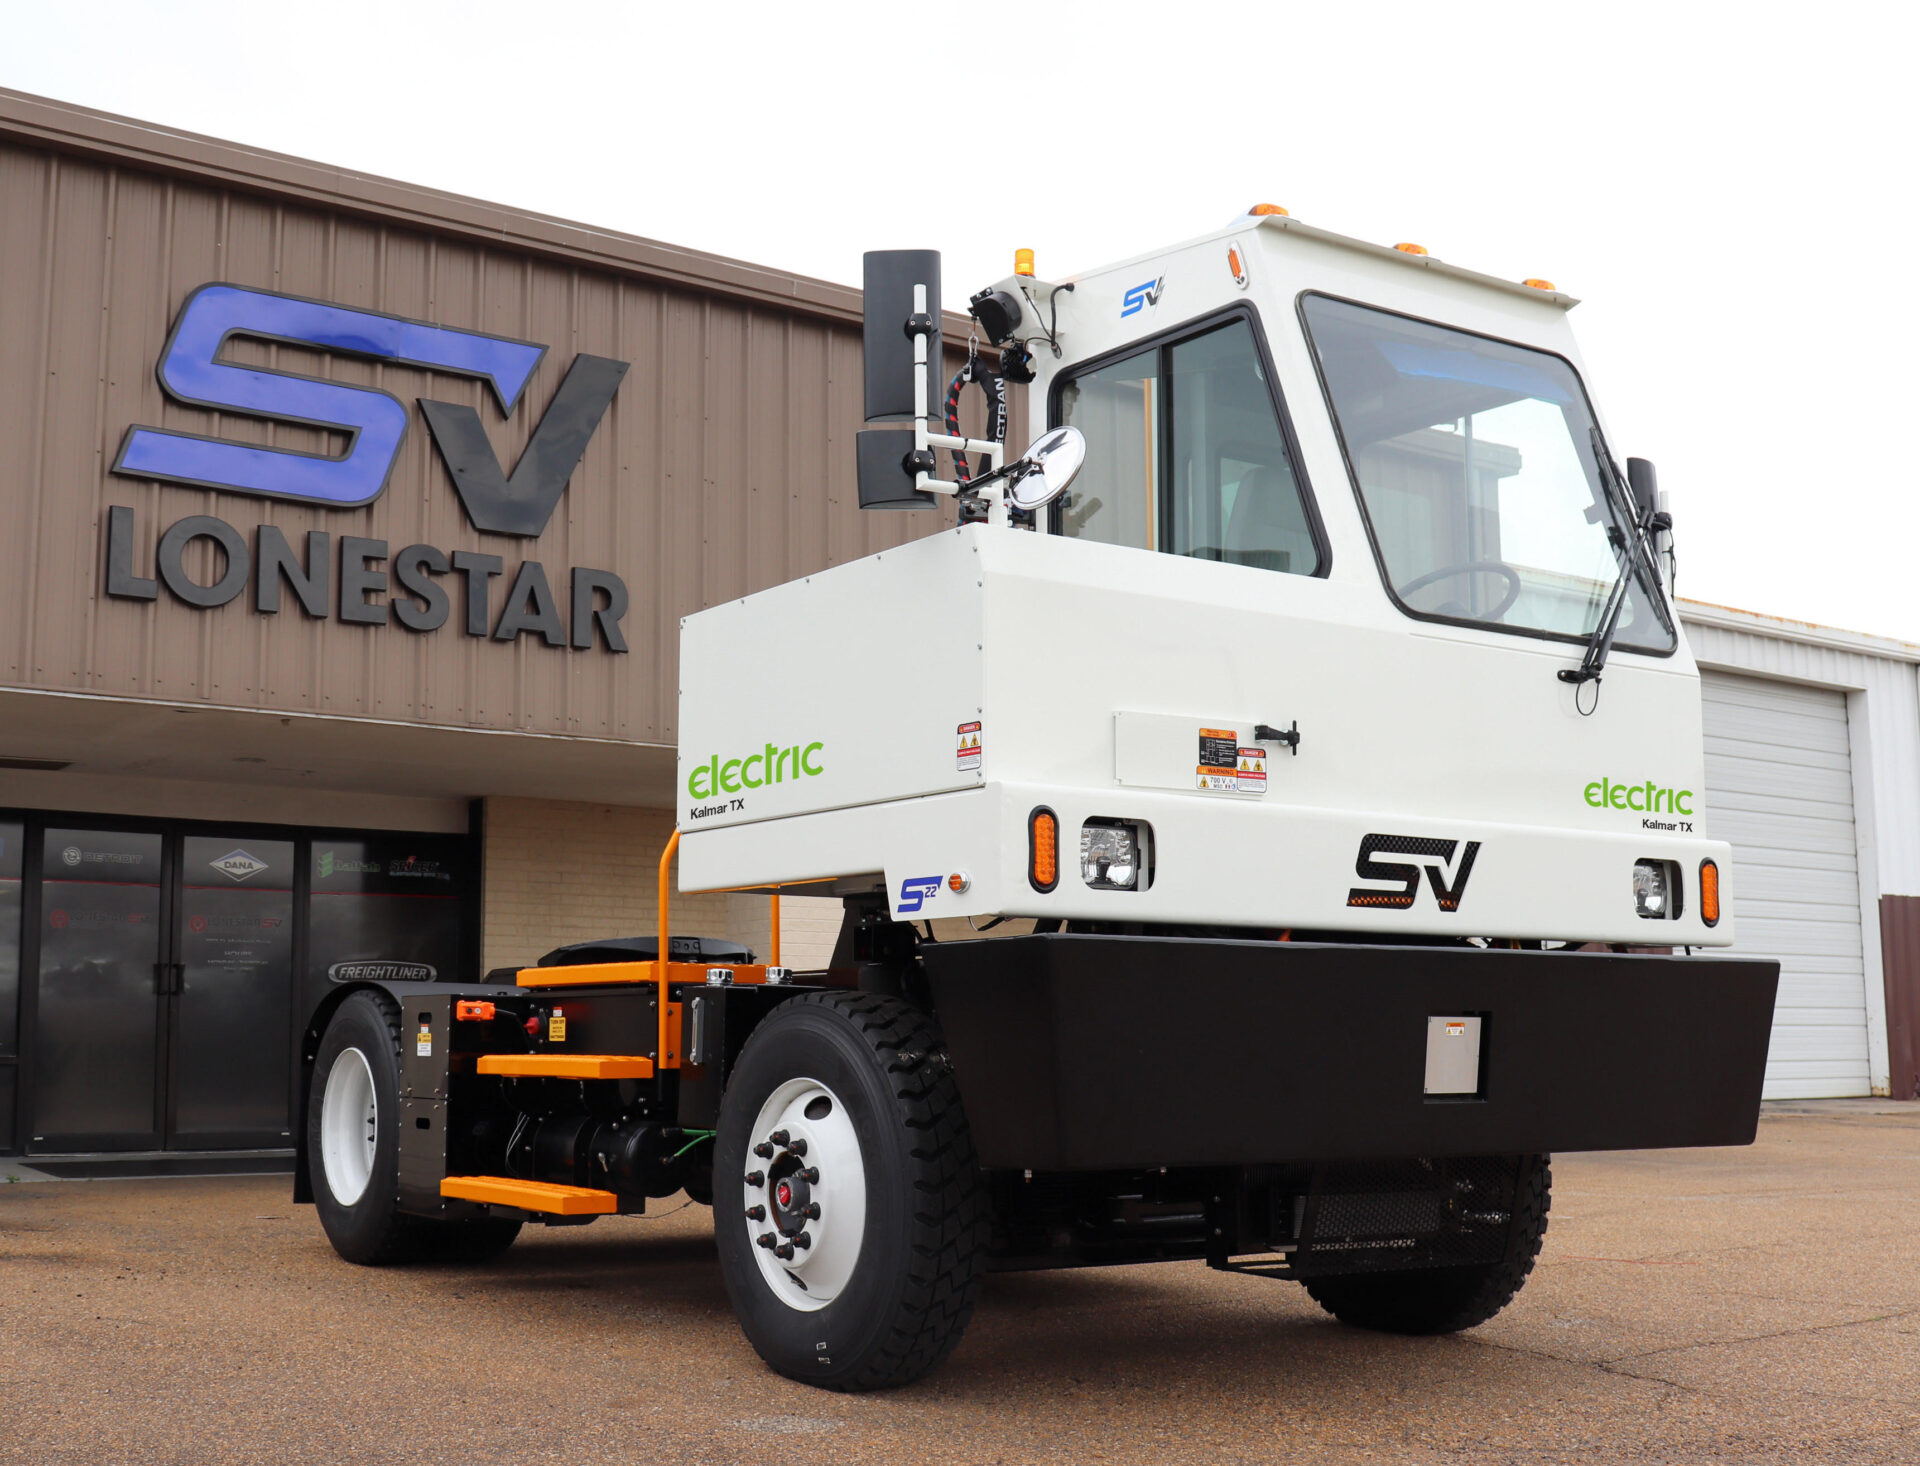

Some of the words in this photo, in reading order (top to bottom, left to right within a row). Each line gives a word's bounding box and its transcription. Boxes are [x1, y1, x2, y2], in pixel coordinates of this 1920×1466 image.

[1121, 275, 1166, 319] SV
[111, 281, 631, 538] SV
[107, 505, 629, 654] LONESTAR
[688, 741, 824, 799] electric
[1207, 768, 1234, 776] WARNING
[690, 803, 728, 820] Kalmar
[730, 798, 744, 811] TX
[1584, 777, 1693, 816] electric
[1642, 819, 1677, 832] Kalmar
[1679, 822, 1693, 832] TX
[83, 852, 143, 865] DETROIT
[224, 861, 254, 870] DANA
[1346, 833, 1482, 913] SV
[339, 965, 428, 980] FREIGHTLINER
